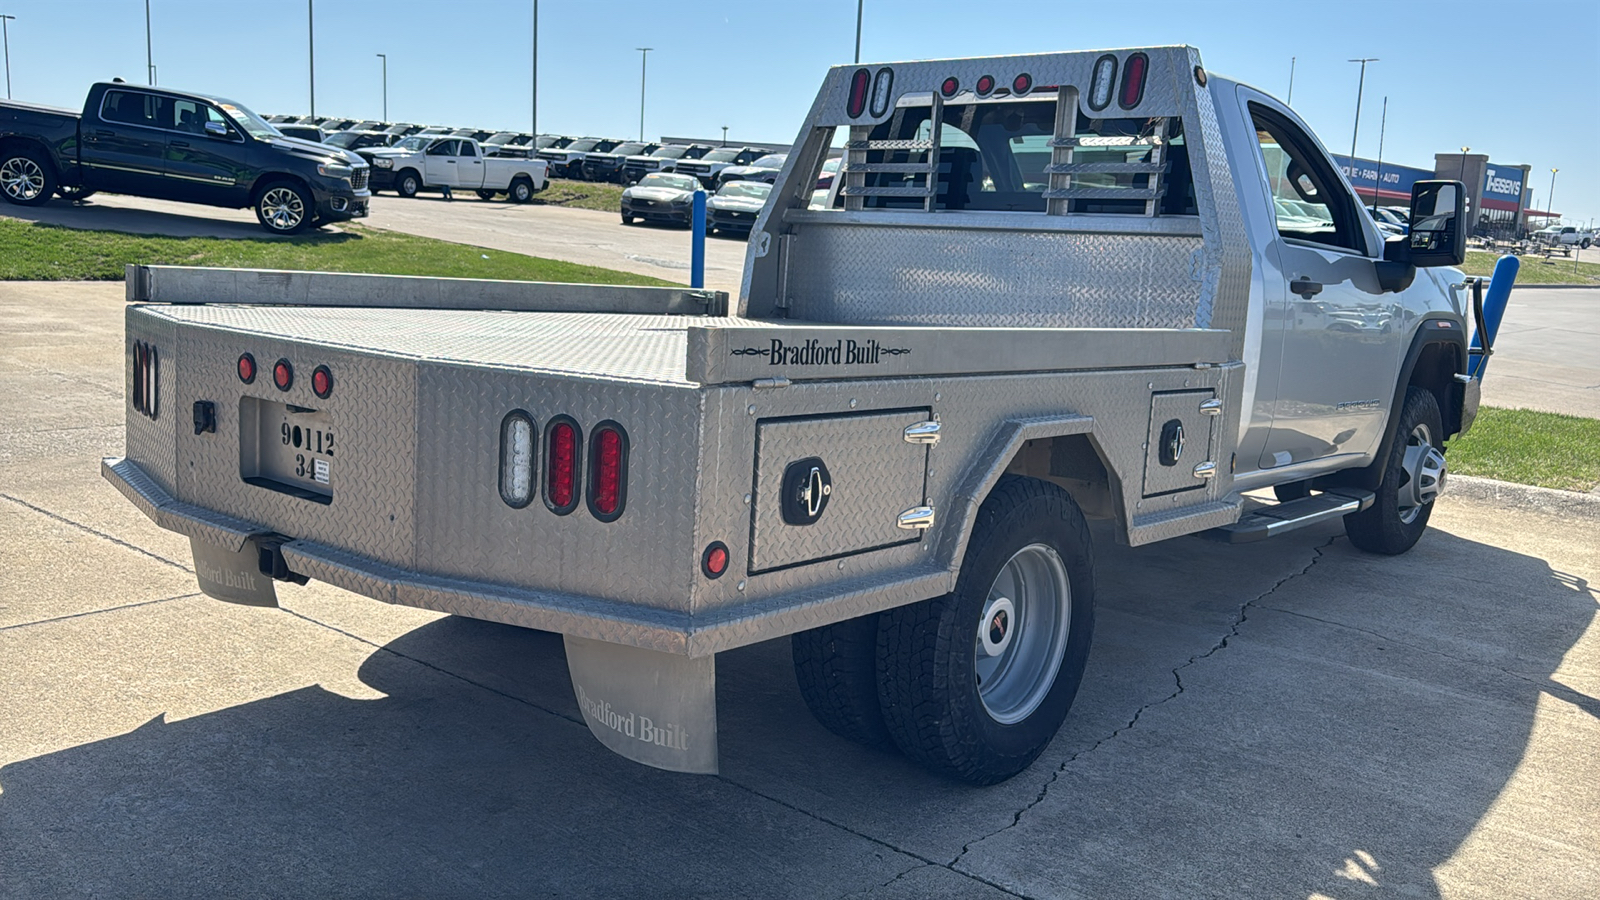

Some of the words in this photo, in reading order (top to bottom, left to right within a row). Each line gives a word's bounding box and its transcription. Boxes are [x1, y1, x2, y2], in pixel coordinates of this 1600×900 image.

[1383, 172, 1400, 184] AUTO
[769, 338, 842, 366] Bradford
[845, 339, 881, 365] Built
[281, 422, 334, 456] 90112
[296, 453, 316, 480] 34
[225, 568, 257, 591] Built
[578, 684, 635, 738] Bradford
[639, 715, 689, 751] Built
